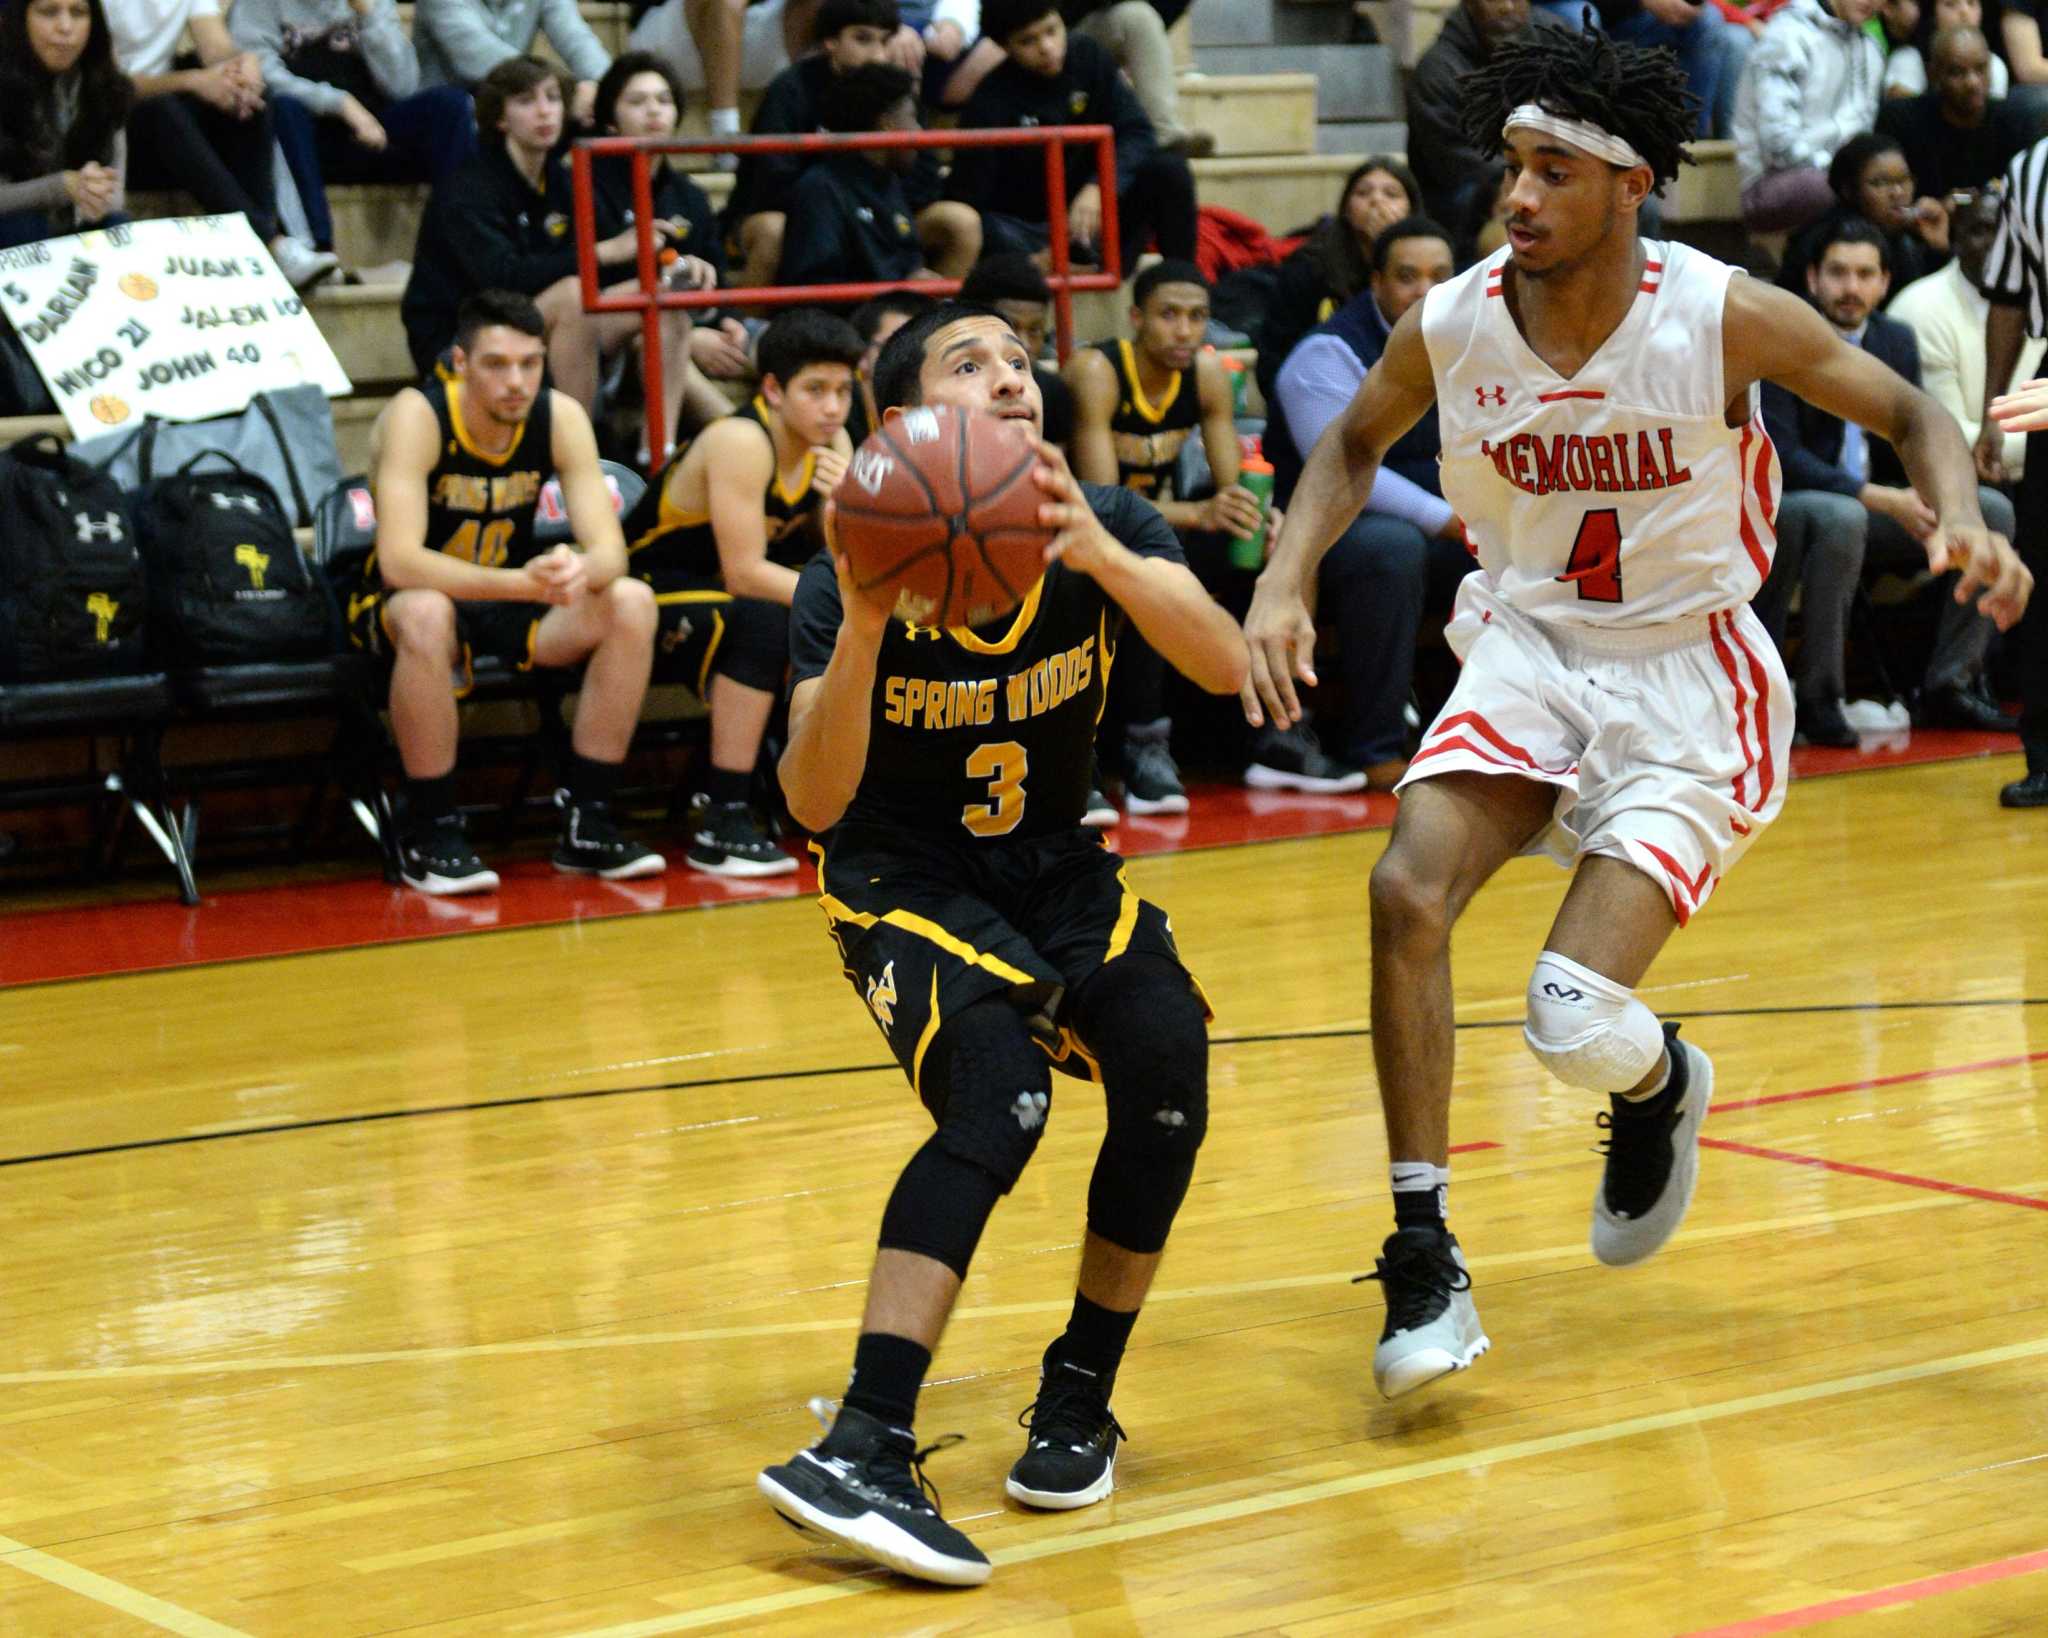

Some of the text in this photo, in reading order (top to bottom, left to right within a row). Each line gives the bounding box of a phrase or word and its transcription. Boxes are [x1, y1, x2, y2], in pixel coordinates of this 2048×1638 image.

[2, 281, 30, 305] 5
[22, 256, 99, 343] DARIAN
[164, 255, 266, 277] JUAN 3
[180, 297, 304, 330] JALEN 10
[53, 317, 151, 396] NICO 21
[137, 343, 262, 391] JOHN 40
[1555, 507, 1623, 603] 4
[886, 635, 1094, 730] SPRING WOODS
[961, 740, 1029, 838] 3
